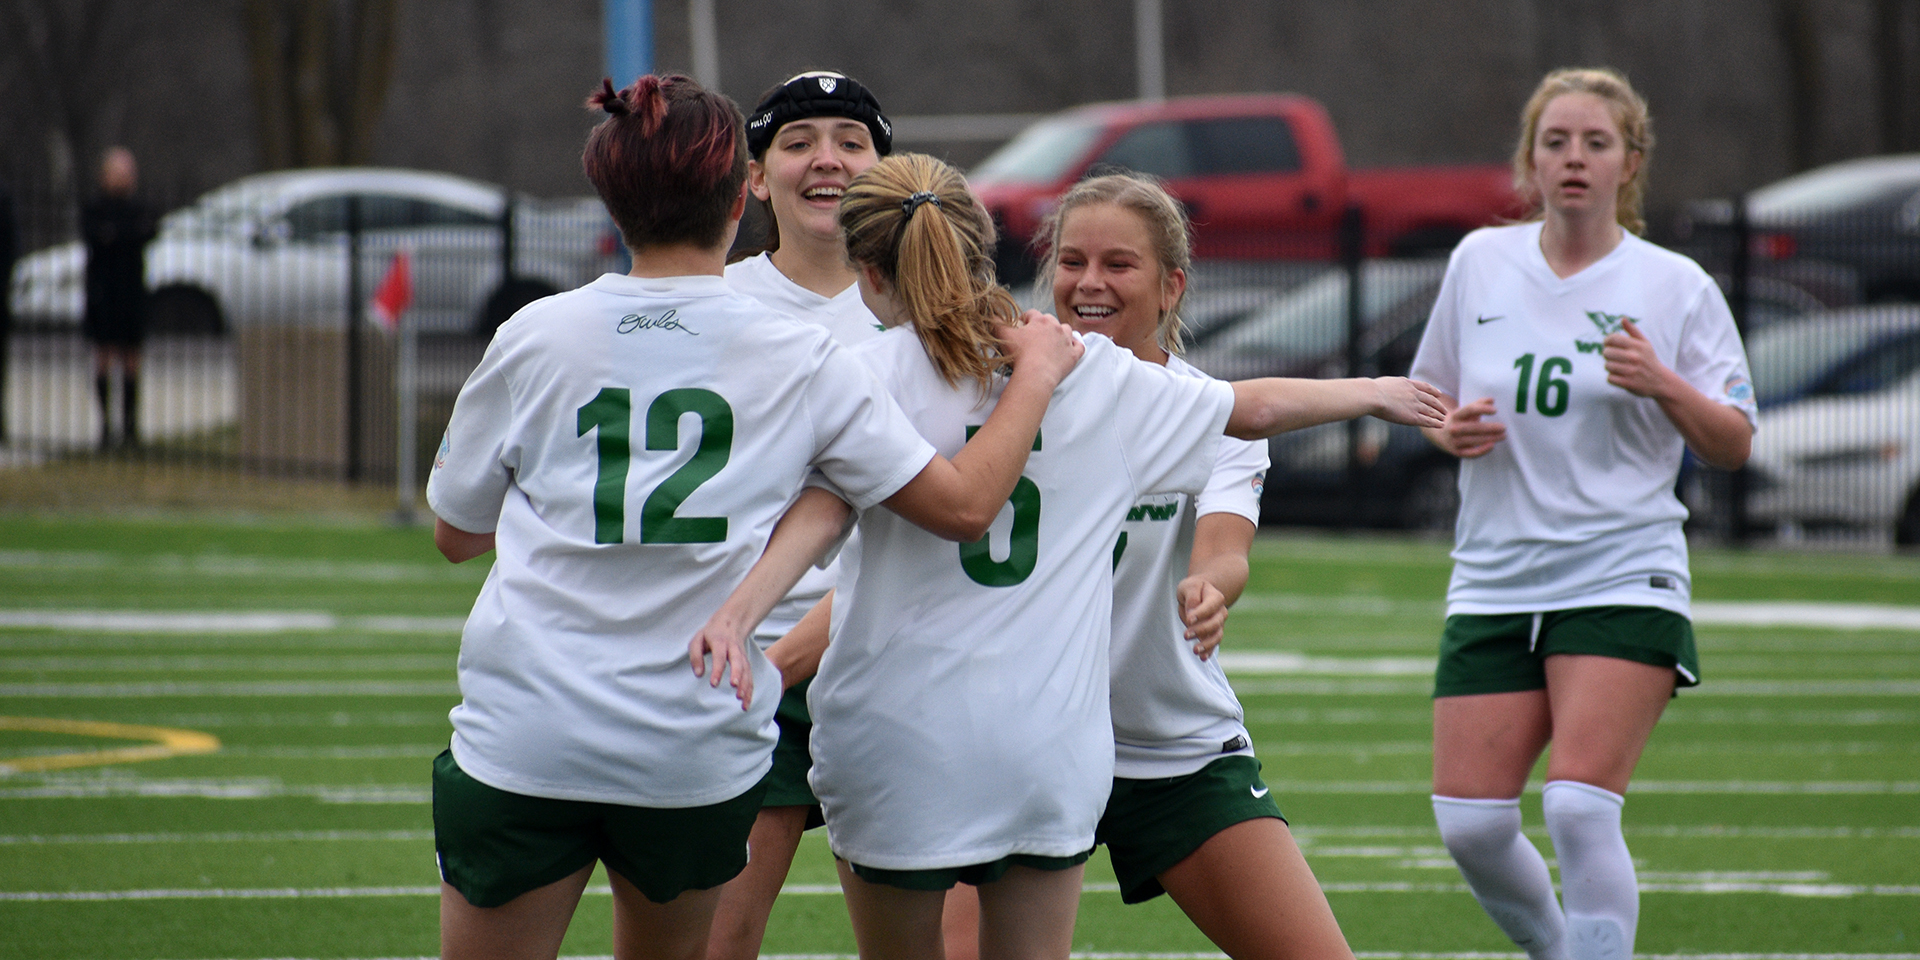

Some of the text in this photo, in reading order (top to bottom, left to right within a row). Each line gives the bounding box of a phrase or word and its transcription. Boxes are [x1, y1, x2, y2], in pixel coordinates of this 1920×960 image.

[617, 309, 700, 336] Owls
[1513, 353, 1573, 417] 16
[577, 387, 734, 544] 12
